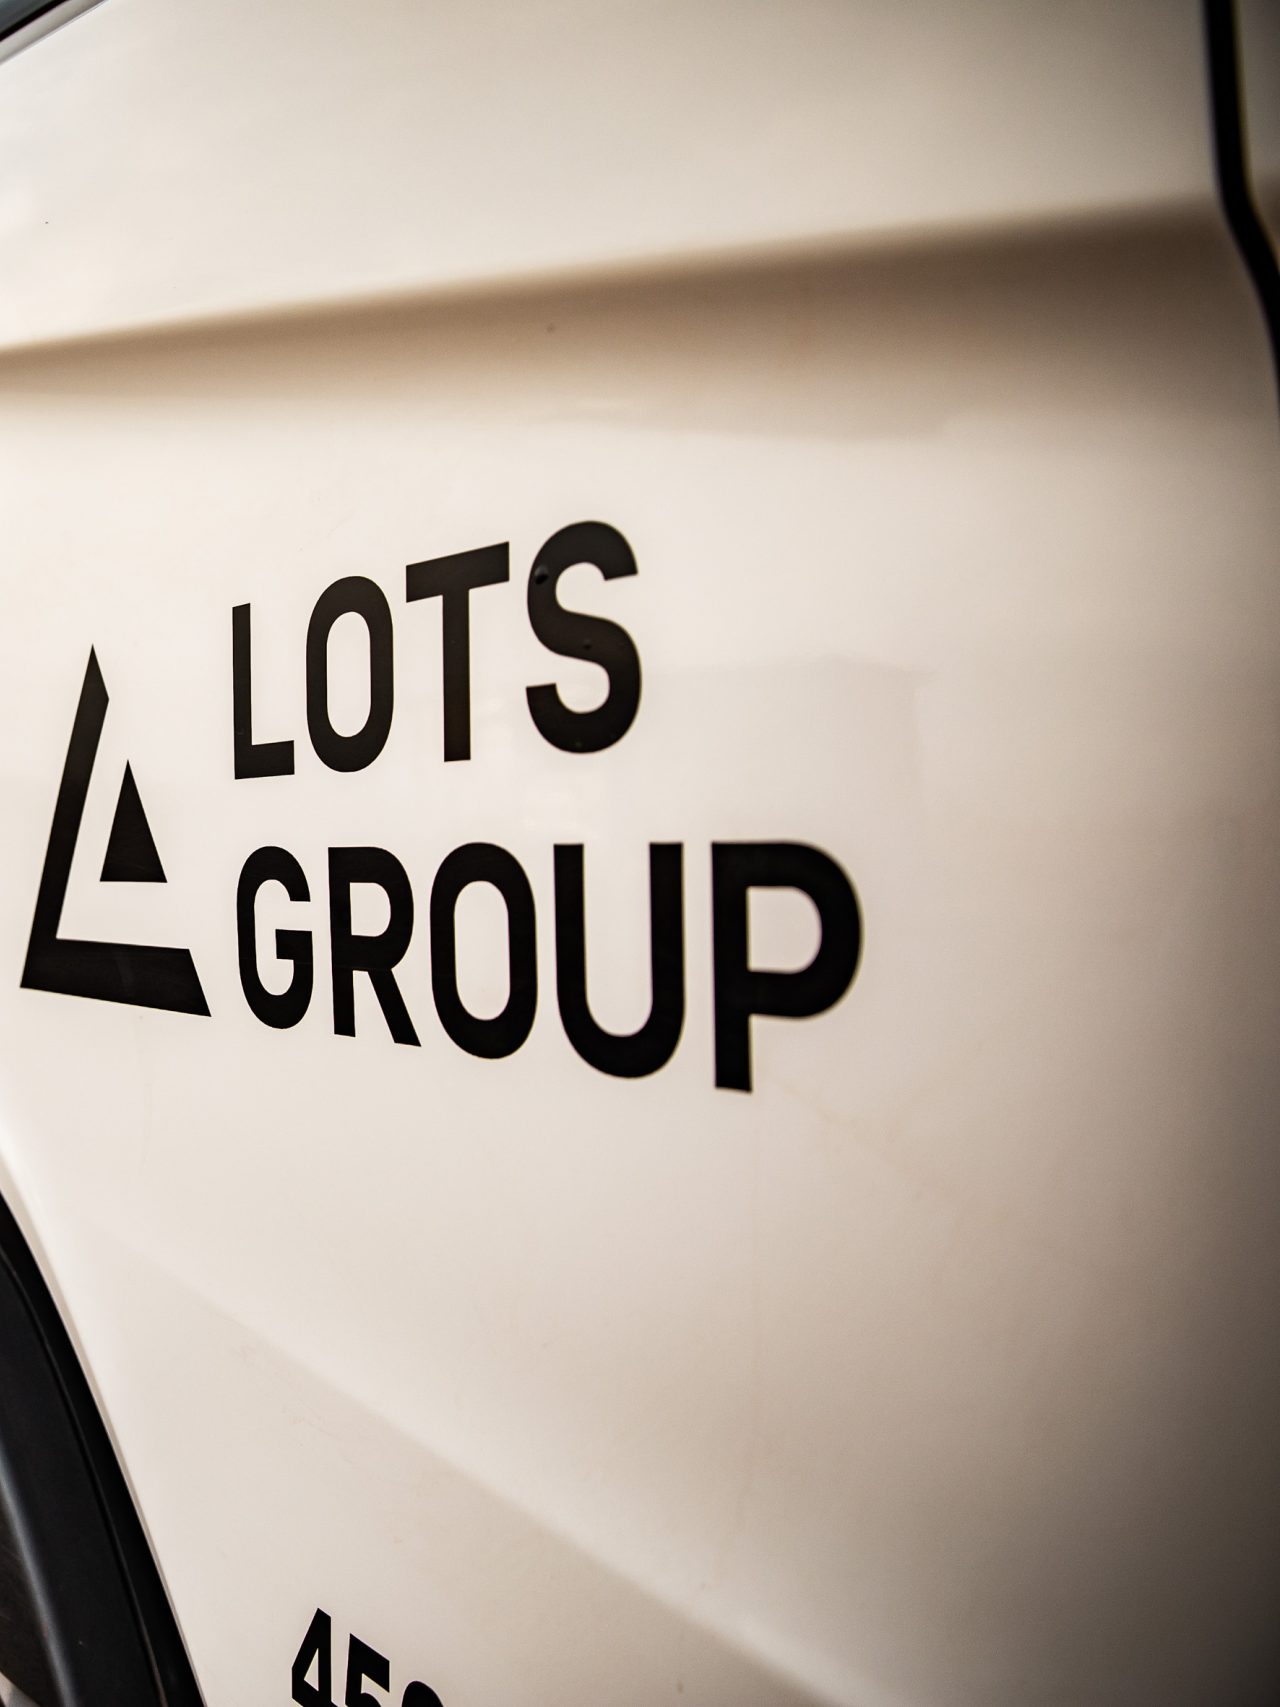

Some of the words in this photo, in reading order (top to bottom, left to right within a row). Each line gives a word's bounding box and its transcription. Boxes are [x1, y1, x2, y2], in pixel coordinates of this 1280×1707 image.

[232, 521, 642, 780] LOTS
[236, 841, 862, 1093] GROUP
[291, 1607, 444, 1707] 45
